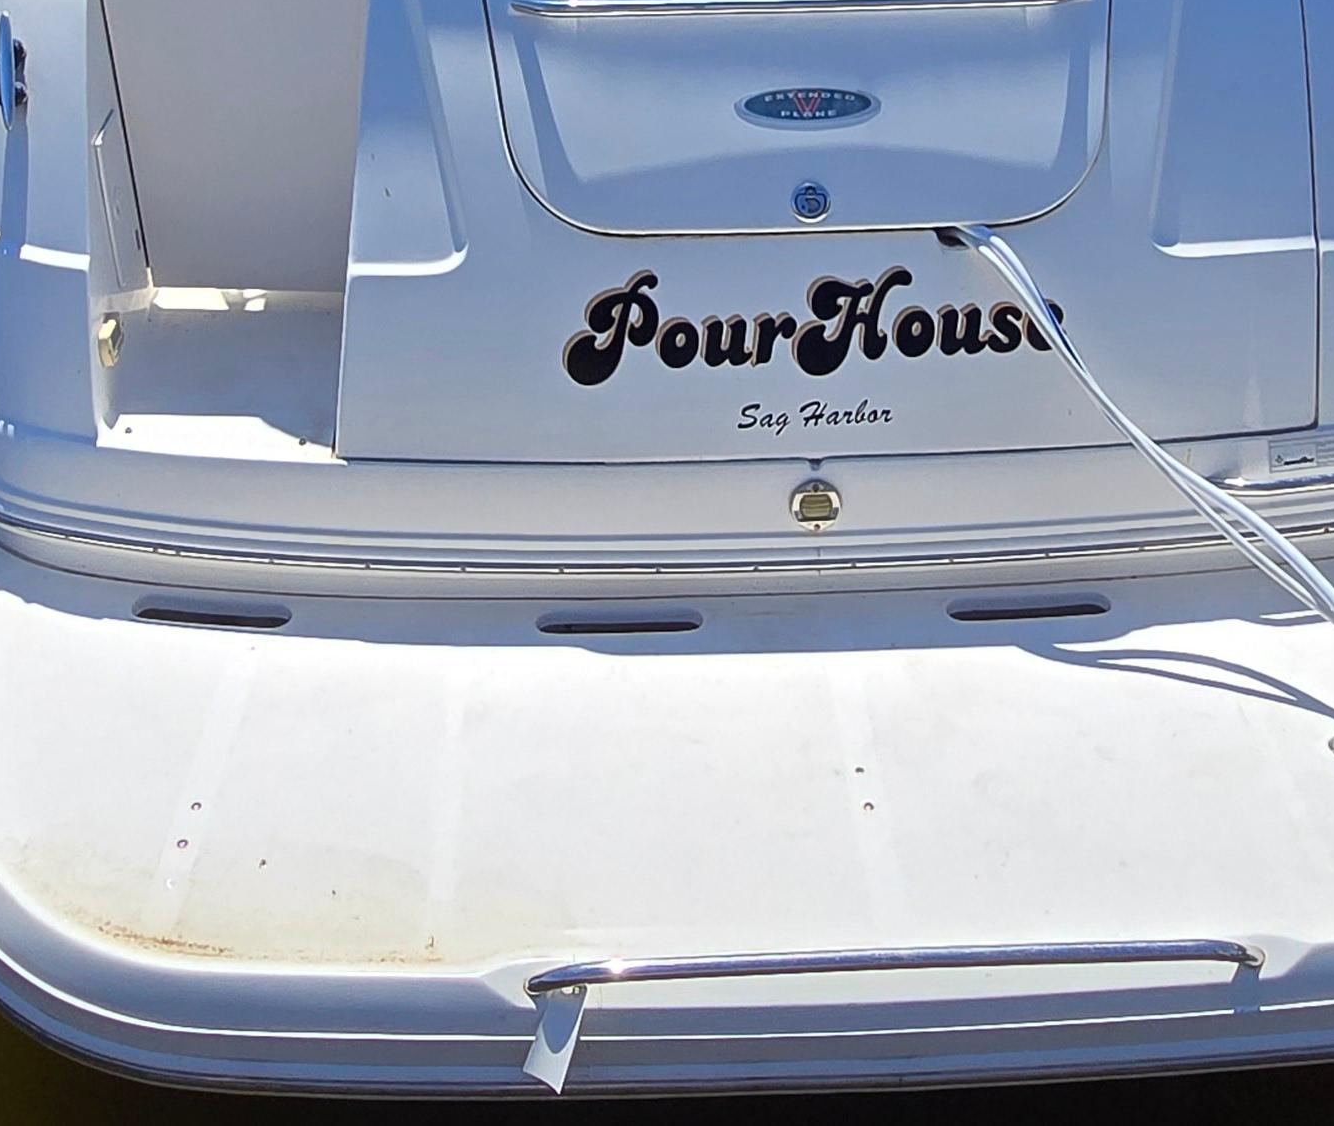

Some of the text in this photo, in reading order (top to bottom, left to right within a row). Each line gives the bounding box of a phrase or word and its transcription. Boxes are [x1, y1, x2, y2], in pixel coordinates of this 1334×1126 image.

[764, 91, 856, 102] EXTENDED
[780, 109, 838, 118] PLANE
[737, 399, 892, 436] Sag Harbor
